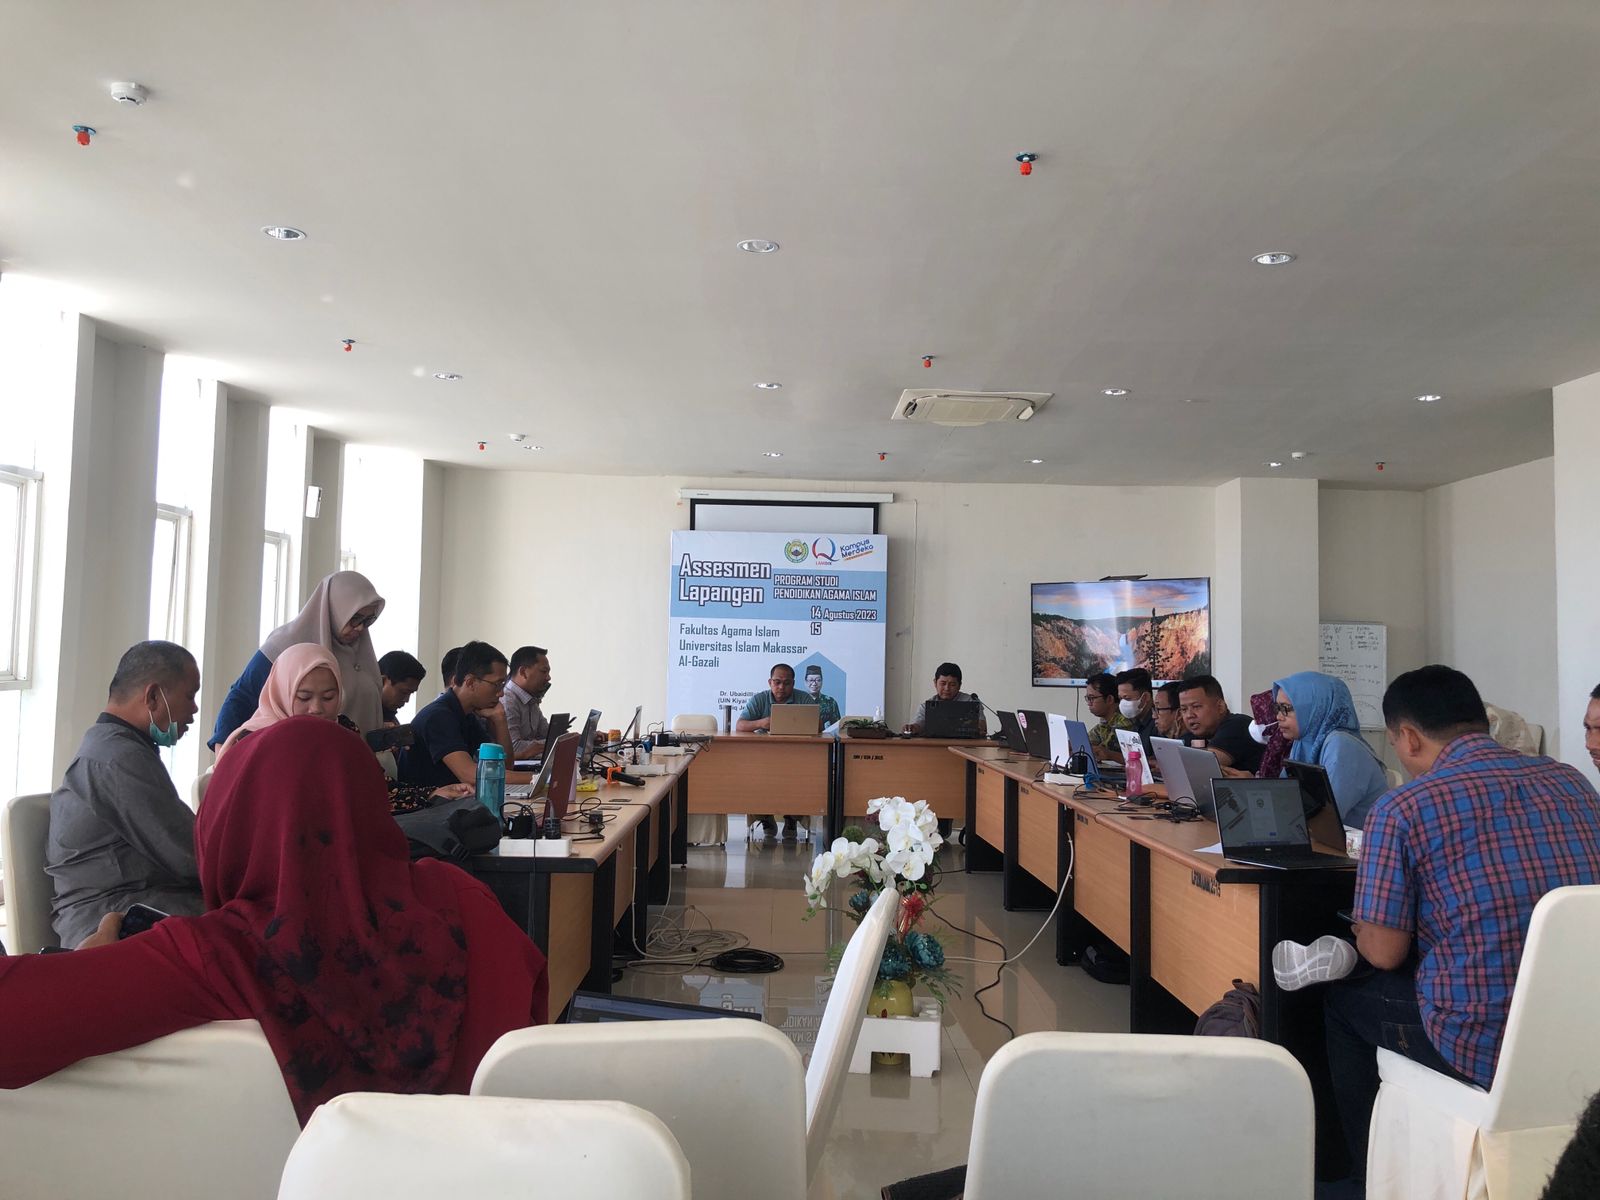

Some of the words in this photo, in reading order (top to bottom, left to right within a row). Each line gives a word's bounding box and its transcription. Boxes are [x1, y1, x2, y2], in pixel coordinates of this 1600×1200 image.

[840, 539, 870, 552] Kampus
[841, 544, 873, 558] Merdeka
[679, 553, 771, 579] Assesmen
[774, 574, 813, 587] PROGRAM
[814, 575, 839, 587] STUDI
[679, 577, 764, 607] Lapangan
[774, 587, 820, 600] PENDIDIKAN
[822, 588, 850, 600] AGAMA
[852, 590, 877, 602] ISLAM
[811, 606, 821, 619] 14
[823, 608, 856, 621] Agustus
[856, 609, 877, 620] 2023
[680, 623, 718, 636] Fakultas
[721, 624, 752, 638] Agama
[755, 625, 780, 637] Islam
[811, 622, 822, 635] 15
[680, 639, 733, 652] Universitas
[735, 641, 760, 653] Islam
[763, 642, 808, 654] Makassar
[679, 655, 719, 668] Al-Gazali
